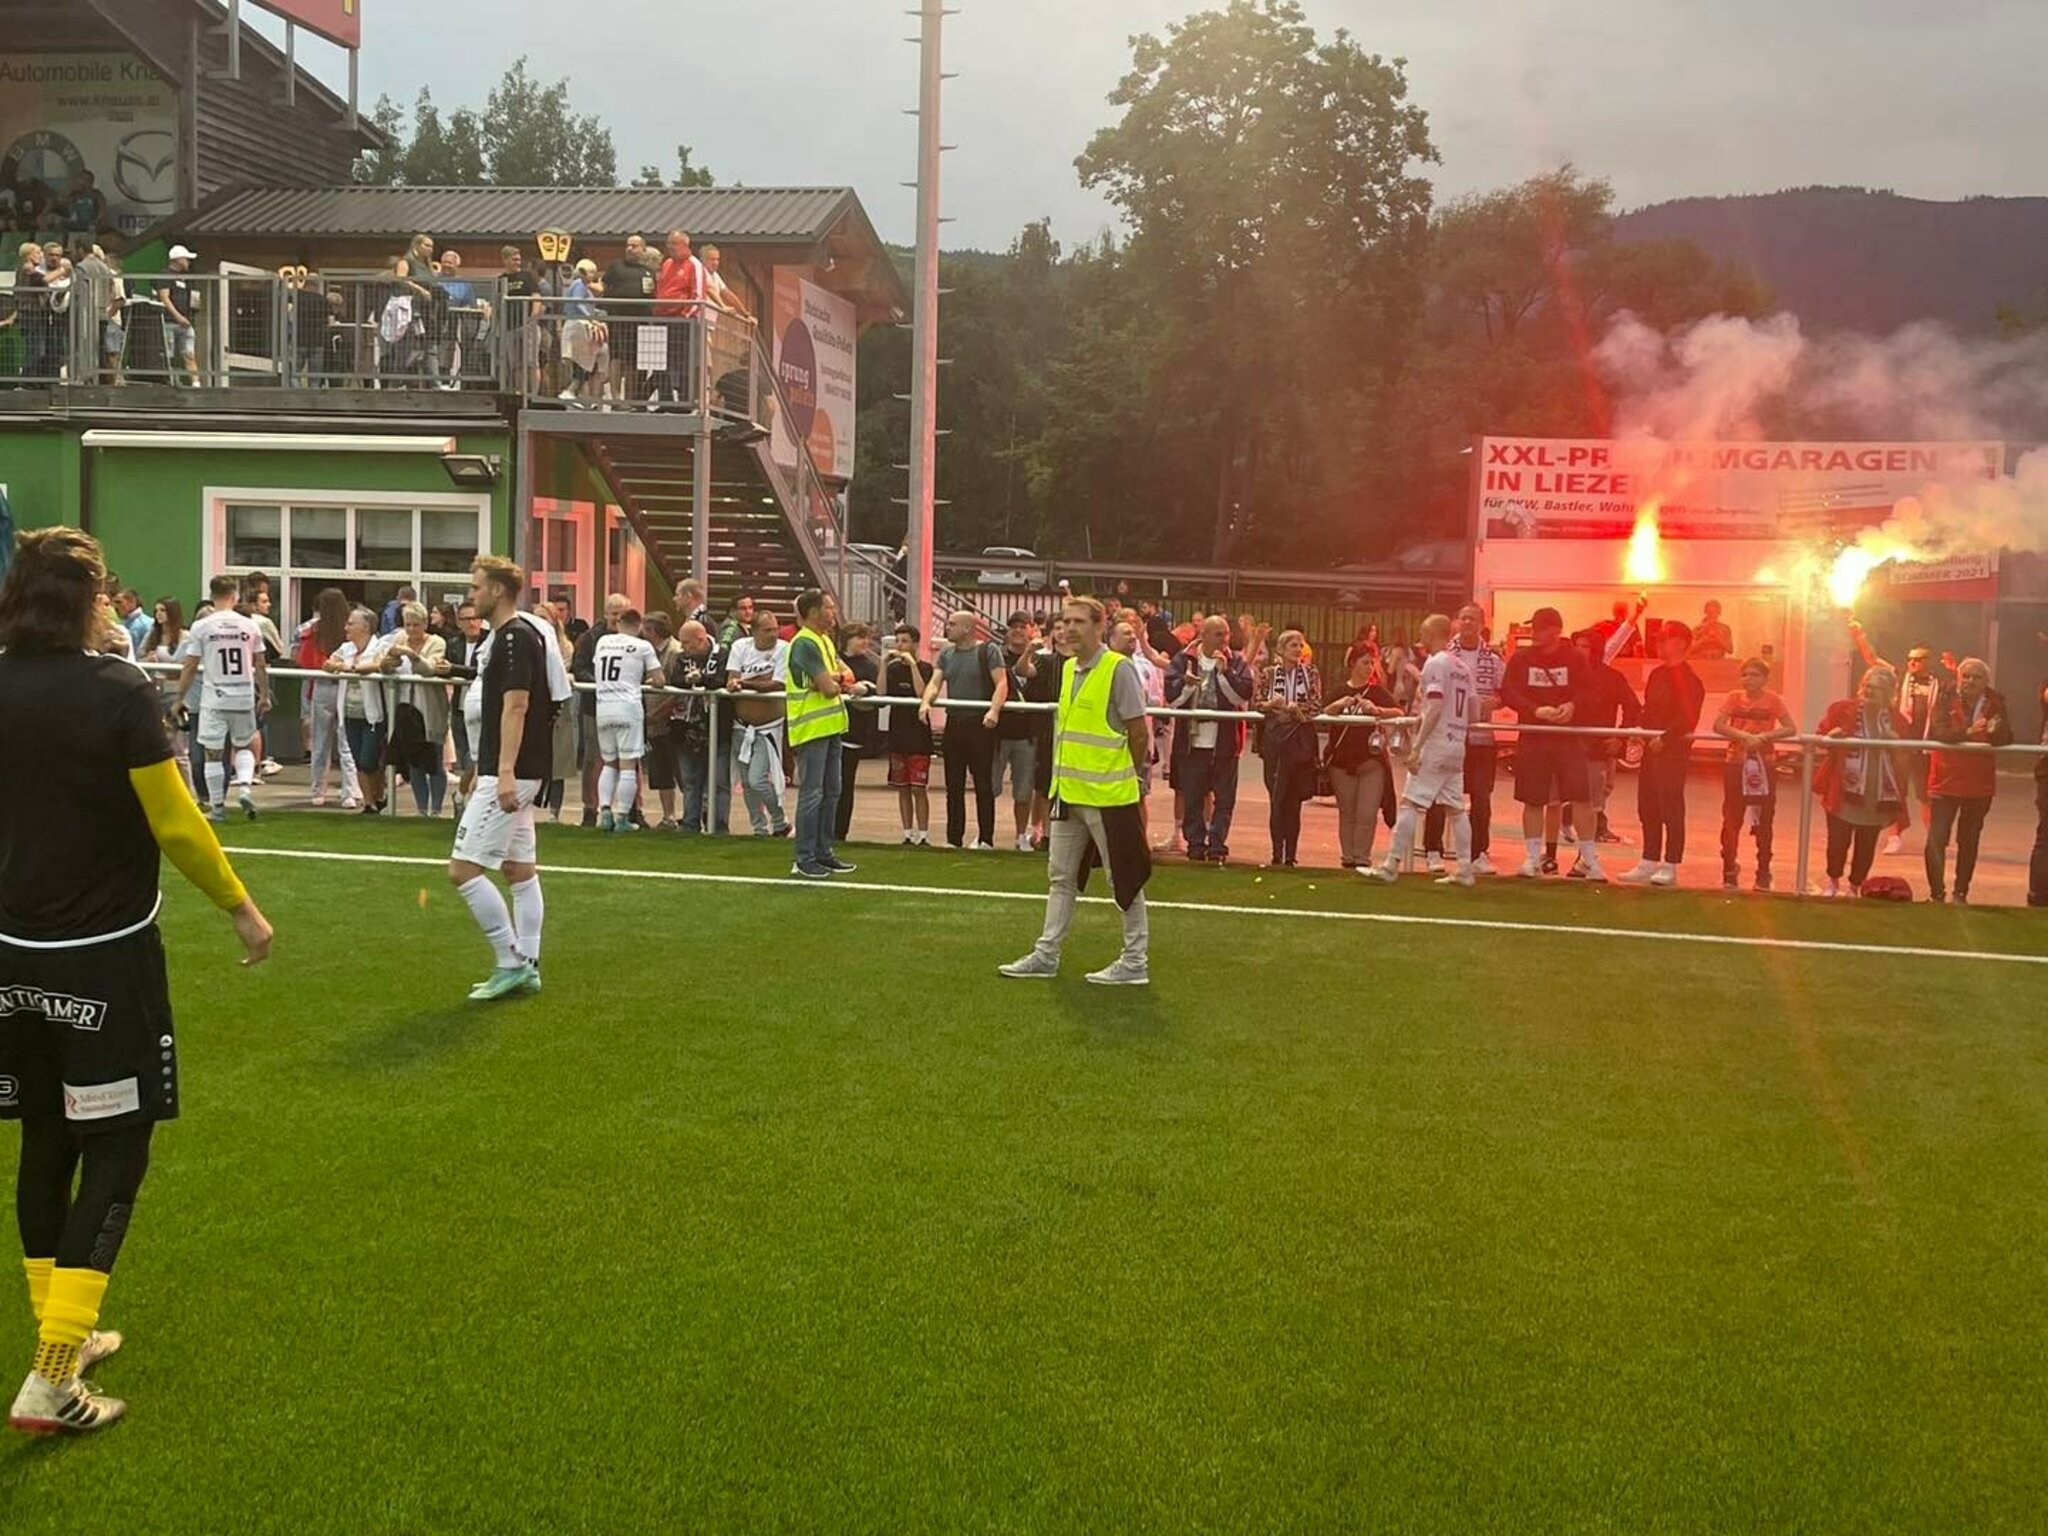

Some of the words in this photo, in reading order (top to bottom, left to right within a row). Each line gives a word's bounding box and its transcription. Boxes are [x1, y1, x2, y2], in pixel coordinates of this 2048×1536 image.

[0, 61, 113, 82] Automobile
[120, 61, 160, 81] Kna
[1488, 444, 1937, 472] XXL-PRMGARAGEN
[1486, 470, 1522, 492] IN
[1534, 472, 1631, 495] LIEZE
[1483, 498, 1504, 509] für
[1543, 501, 1594, 513] Bastler,
[1599, 502, 1687, 515] Wohngen
[217, 647, 243, 676] 19
[600, 655, 623, 682] 16
[0, 989, 97, 1026] NTIGAMER
